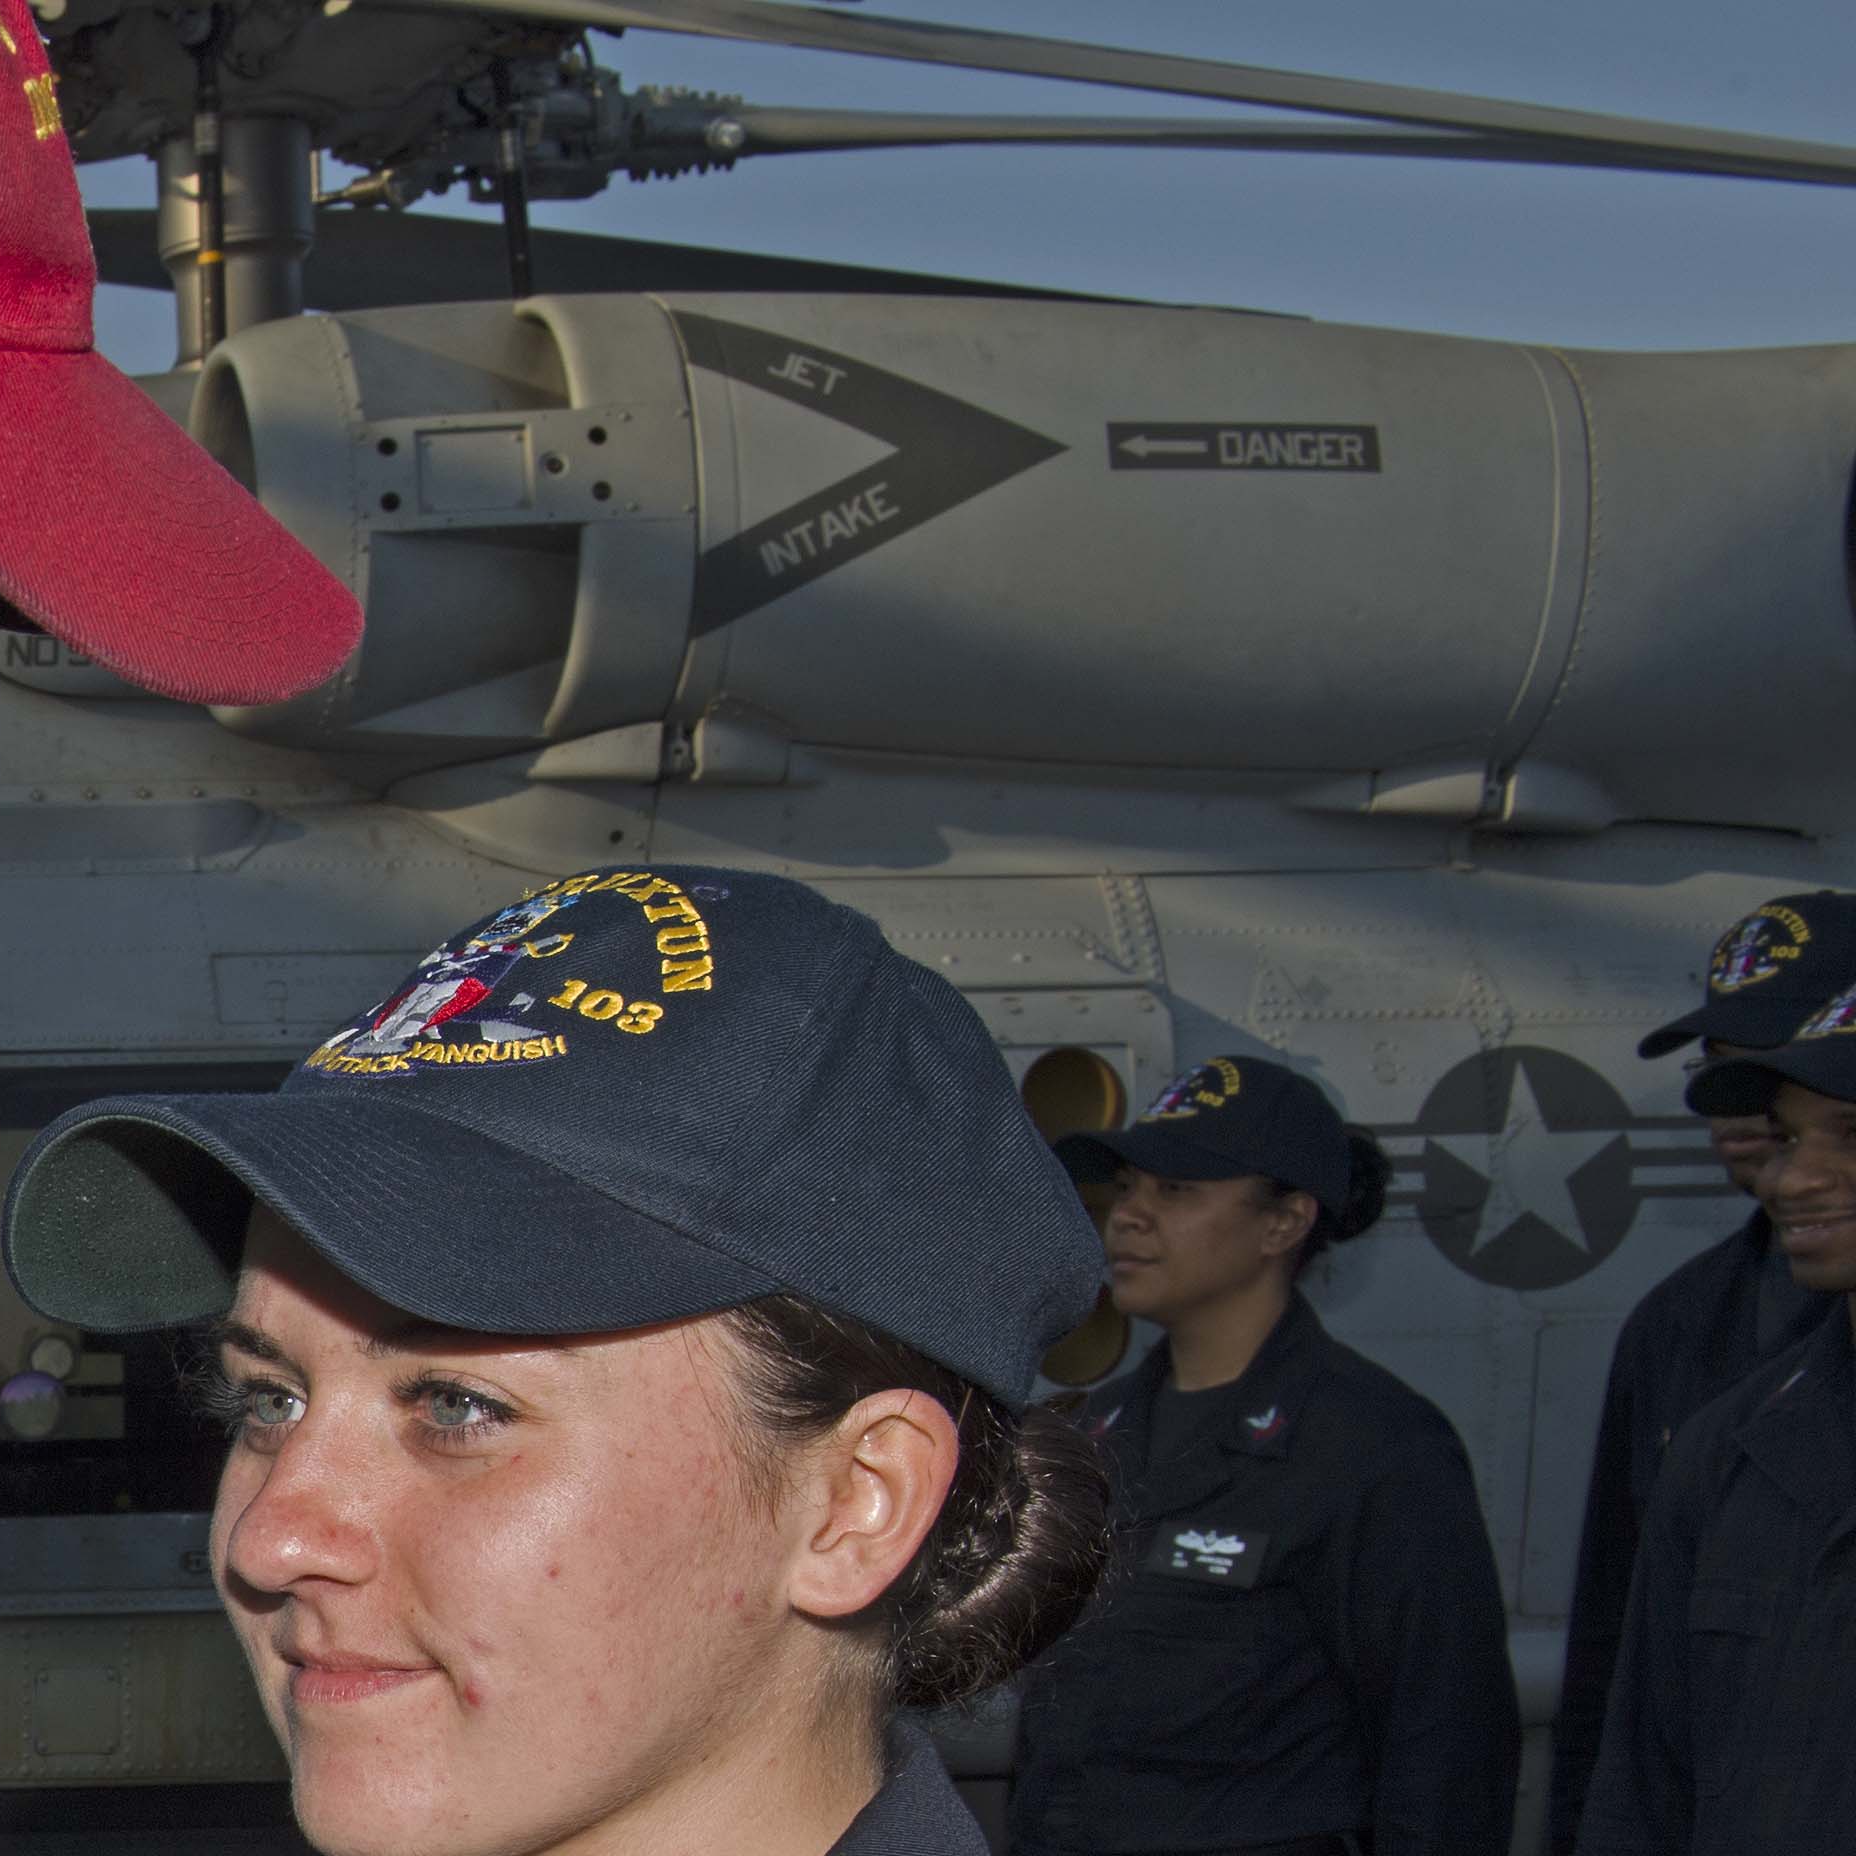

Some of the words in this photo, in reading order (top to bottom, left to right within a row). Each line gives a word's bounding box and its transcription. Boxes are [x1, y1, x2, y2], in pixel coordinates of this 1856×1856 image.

[767, 351, 848, 397] JET
[1218, 429, 1366, 467] DANGER
[759, 482, 900, 577] INTAKE
[5, 635, 59, 668] NO
[544, 872, 714, 993] RUXTUN
[548, 979, 665, 1035] 103
[410, 1034, 568, 1066] VANQUISH
